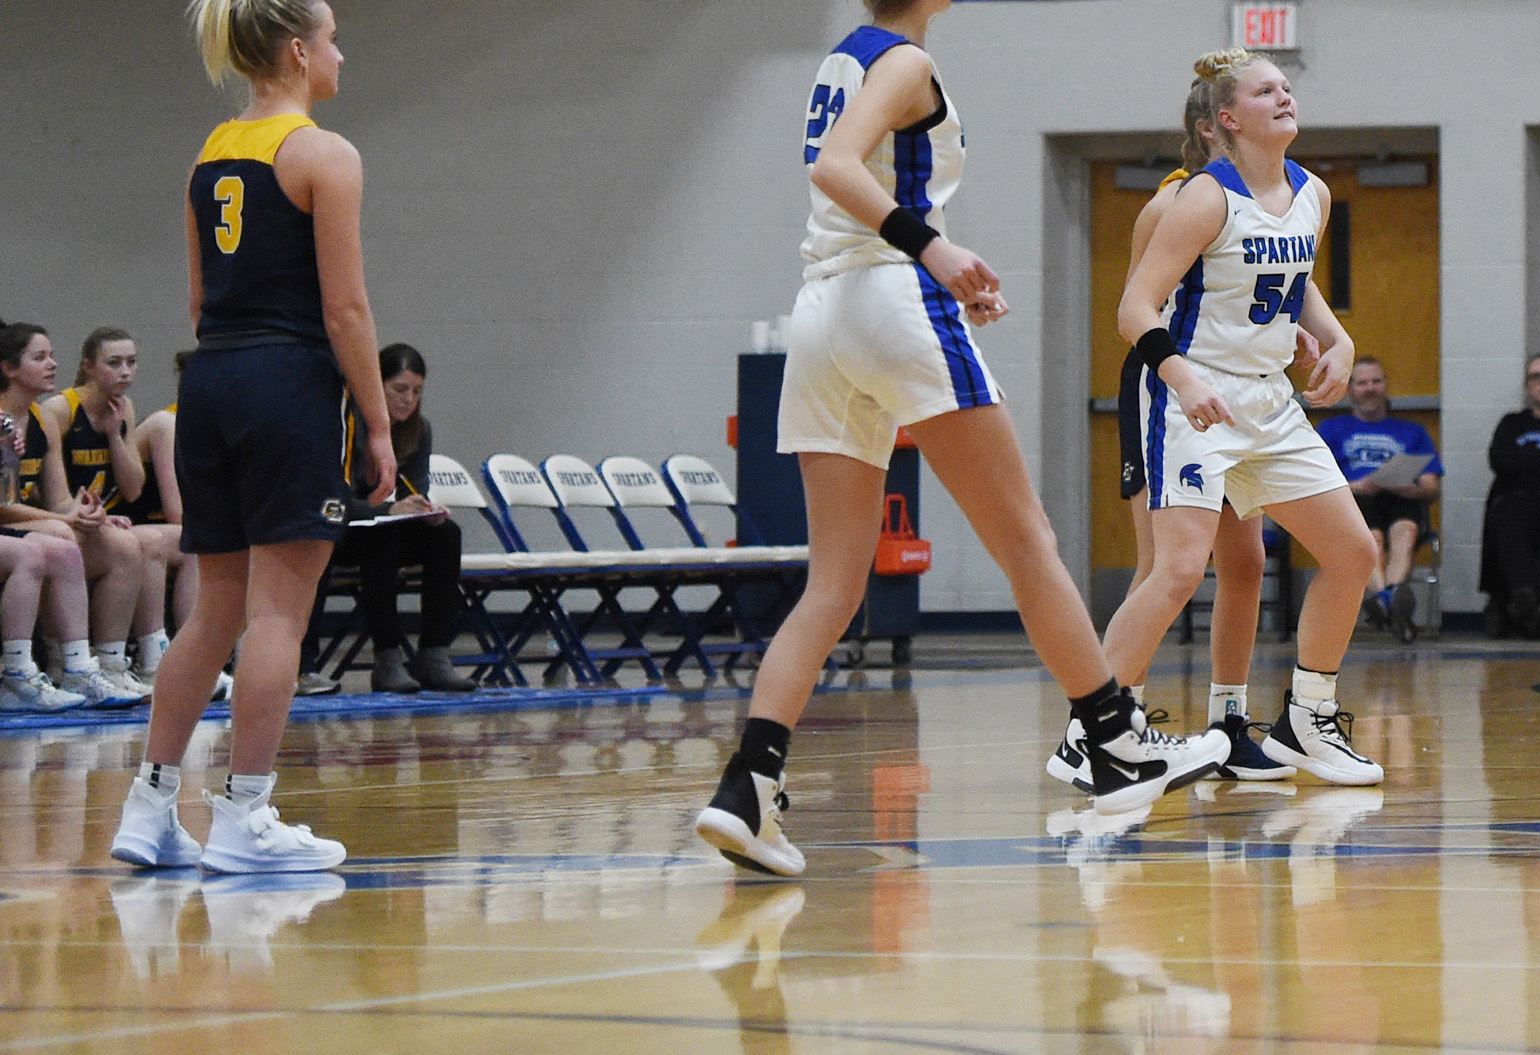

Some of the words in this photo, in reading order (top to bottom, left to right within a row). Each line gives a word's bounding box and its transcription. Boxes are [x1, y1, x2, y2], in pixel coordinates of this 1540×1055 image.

[1245, 9, 1287, 45] EXIT
[214, 176, 244, 254] 3
[1243, 235, 1316, 264] SPARTAN
[1249, 272, 1309, 325] 54
[429, 471, 468, 486] PARTANS
